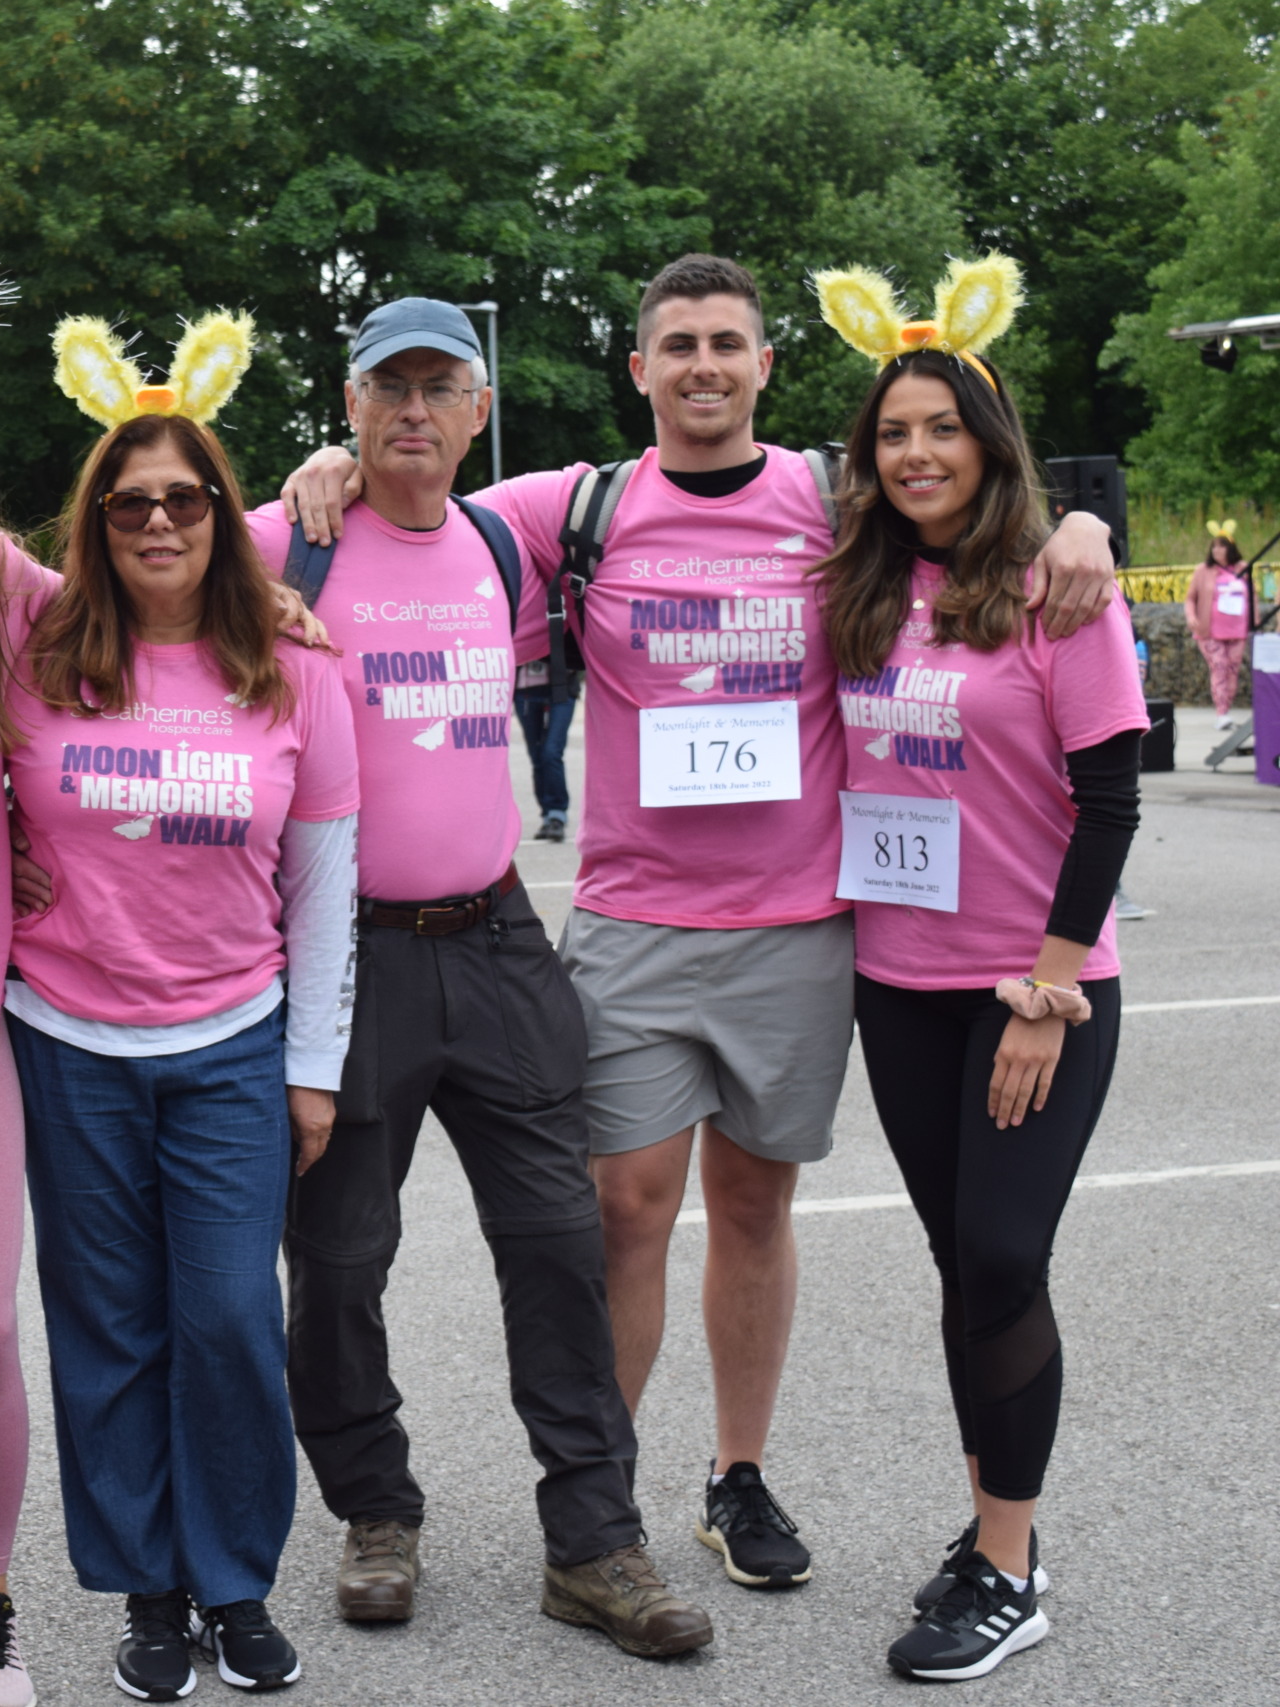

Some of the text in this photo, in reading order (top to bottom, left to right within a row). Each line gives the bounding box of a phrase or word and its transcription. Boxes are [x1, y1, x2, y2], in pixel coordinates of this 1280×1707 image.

[629, 553, 784, 579] St Catherine's
[704, 573, 784, 586] hospice care
[353, 598, 489, 623] St Catherine's
[427, 621, 492, 633] hospice care
[630, 597, 806, 630] MOONLIGHT
[631, 630, 806, 664] & MEMORIES
[362, 648, 509, 685] MOONLIGHT
[721, 662, 805, 694] WALK
[366, 681, 510, 720] & MEMORIES
[841, 694, 963, 739] MEMORIES
[149, 723, 233, 737] hospice care
[451, 716, 508, 749] WALK
[653, 717, 785, 734] Moonlight & Memories
[61, 744, 253, 784] MOONLIGHT
[686, 739, 757, 773] 176
[894, 734, 967, 771] WALK
[60, 775, 254, 818] & MEMORIES
[668, 783, 706, 792] Saturday
[160, 815, 252, 847] WALK
[851, 806, 950, 824] Moonlight & Memories
[874, 832, 928, 871] 813
